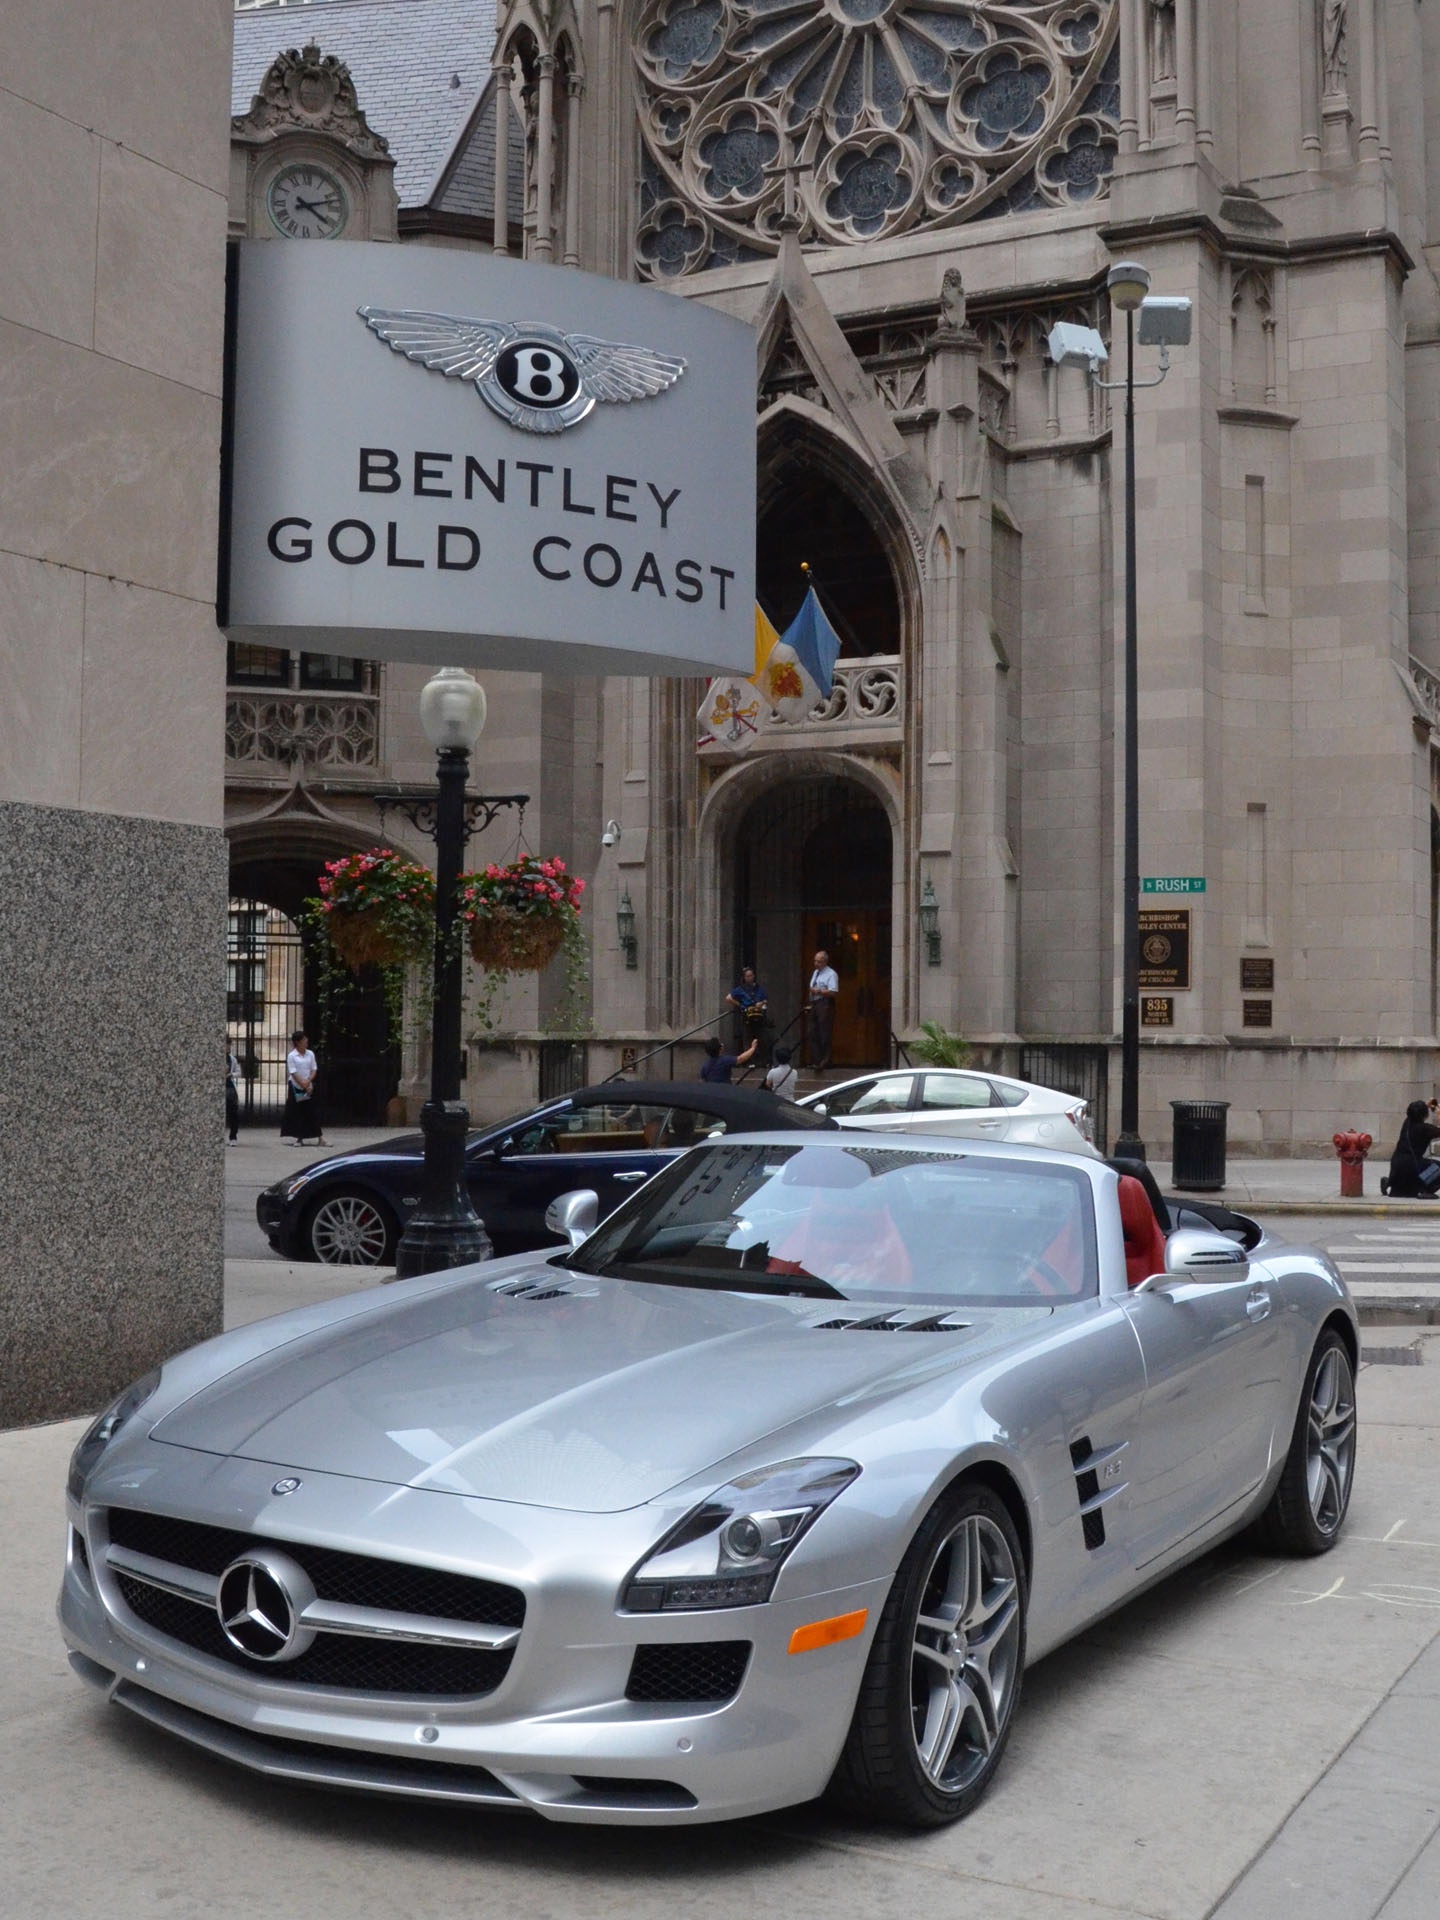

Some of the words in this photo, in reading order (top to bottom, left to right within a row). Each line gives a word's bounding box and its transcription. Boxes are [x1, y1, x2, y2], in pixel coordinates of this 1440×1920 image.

[513, 347, 565, 402] B
[358, 446, 682, 529] BENTLEY
[266, 516, 481, 571] GOLD
[532, 535, 735, 610] COAST
[1155, 879, 1190, 891] RUSH
[1194, 881, 1202, 889] ST
[1160, 922, 1187, 930] CENTER
[1147, 999, 1168, 1011] 835
